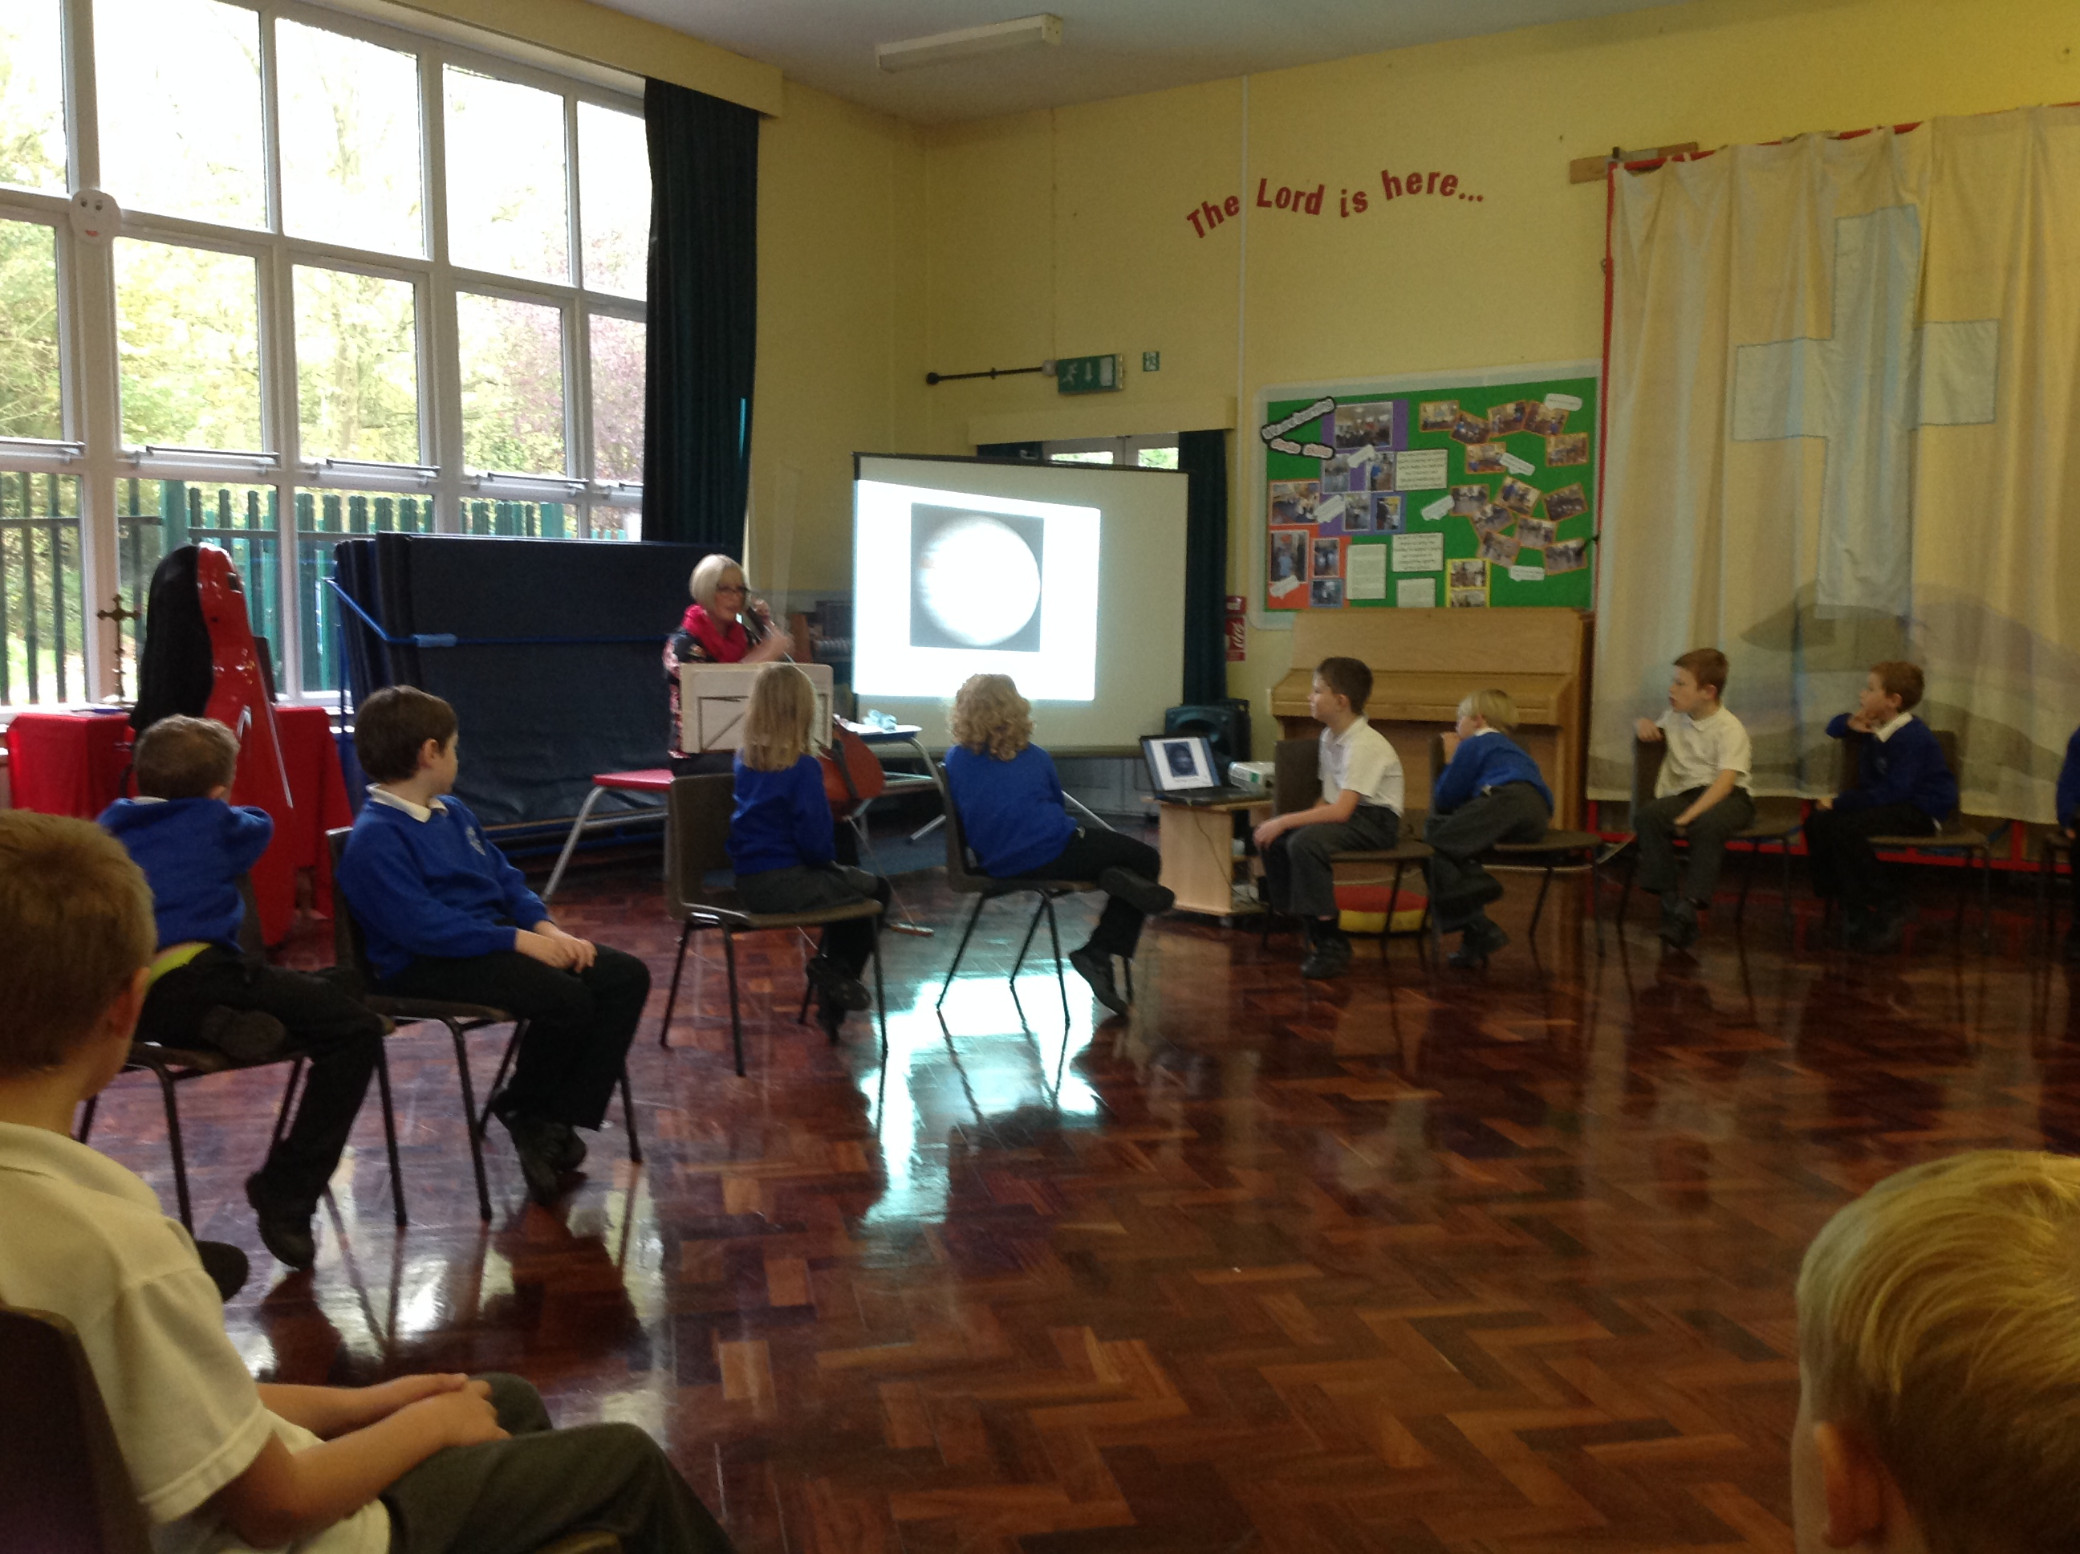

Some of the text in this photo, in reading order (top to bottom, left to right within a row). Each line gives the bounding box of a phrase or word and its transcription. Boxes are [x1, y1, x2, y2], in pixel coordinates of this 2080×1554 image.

[1186, 170, 1484, 237] The Lord is here...
